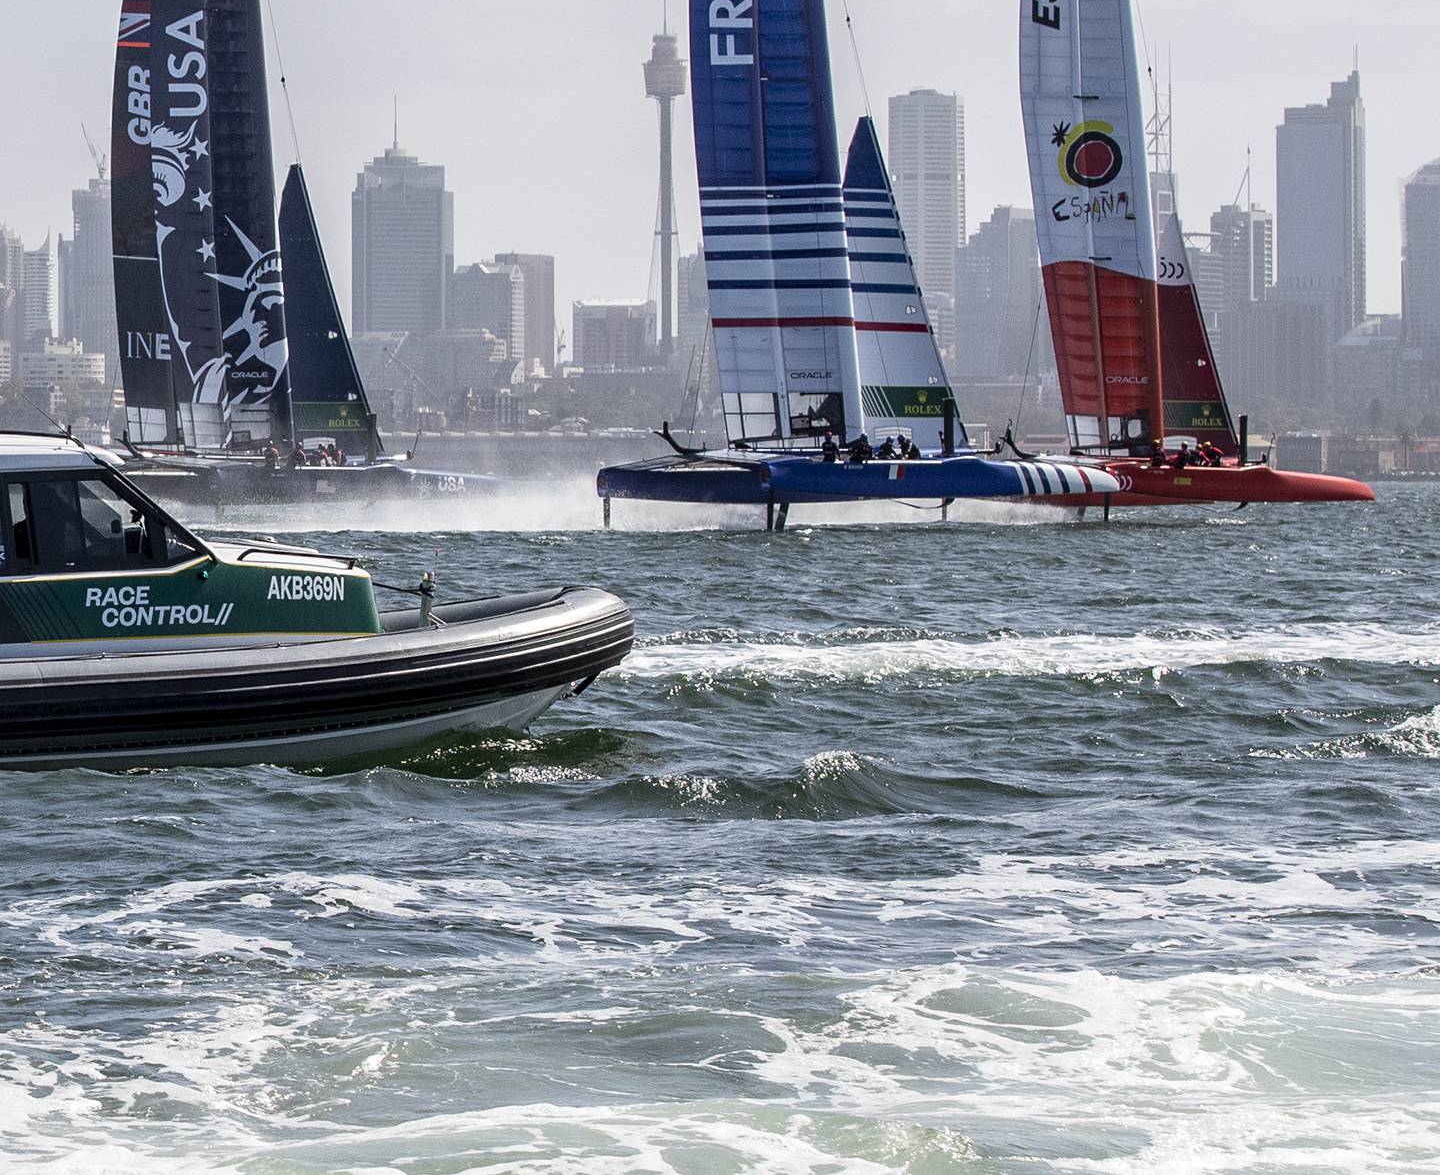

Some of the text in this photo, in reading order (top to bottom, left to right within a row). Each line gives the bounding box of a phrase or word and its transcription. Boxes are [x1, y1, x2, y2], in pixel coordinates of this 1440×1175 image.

[165, 9, 208, 117] USA
[127, 65, 152, 145] GBR
[126, 331, 172, 360] INE
[790, 371, 833, 379] ORACLE
[1105, 376, 1148, 384] ORACLE
[904, 405, 942, 414] ROLEX
[328, 418, 361, 427] ROLEX
[1191, 417, 1222, 426] ROLEX
[438, 476, 466, 492] USA
[267, 575, 345, 601] AKB369N
[85, 586, 150, 607] RACE
